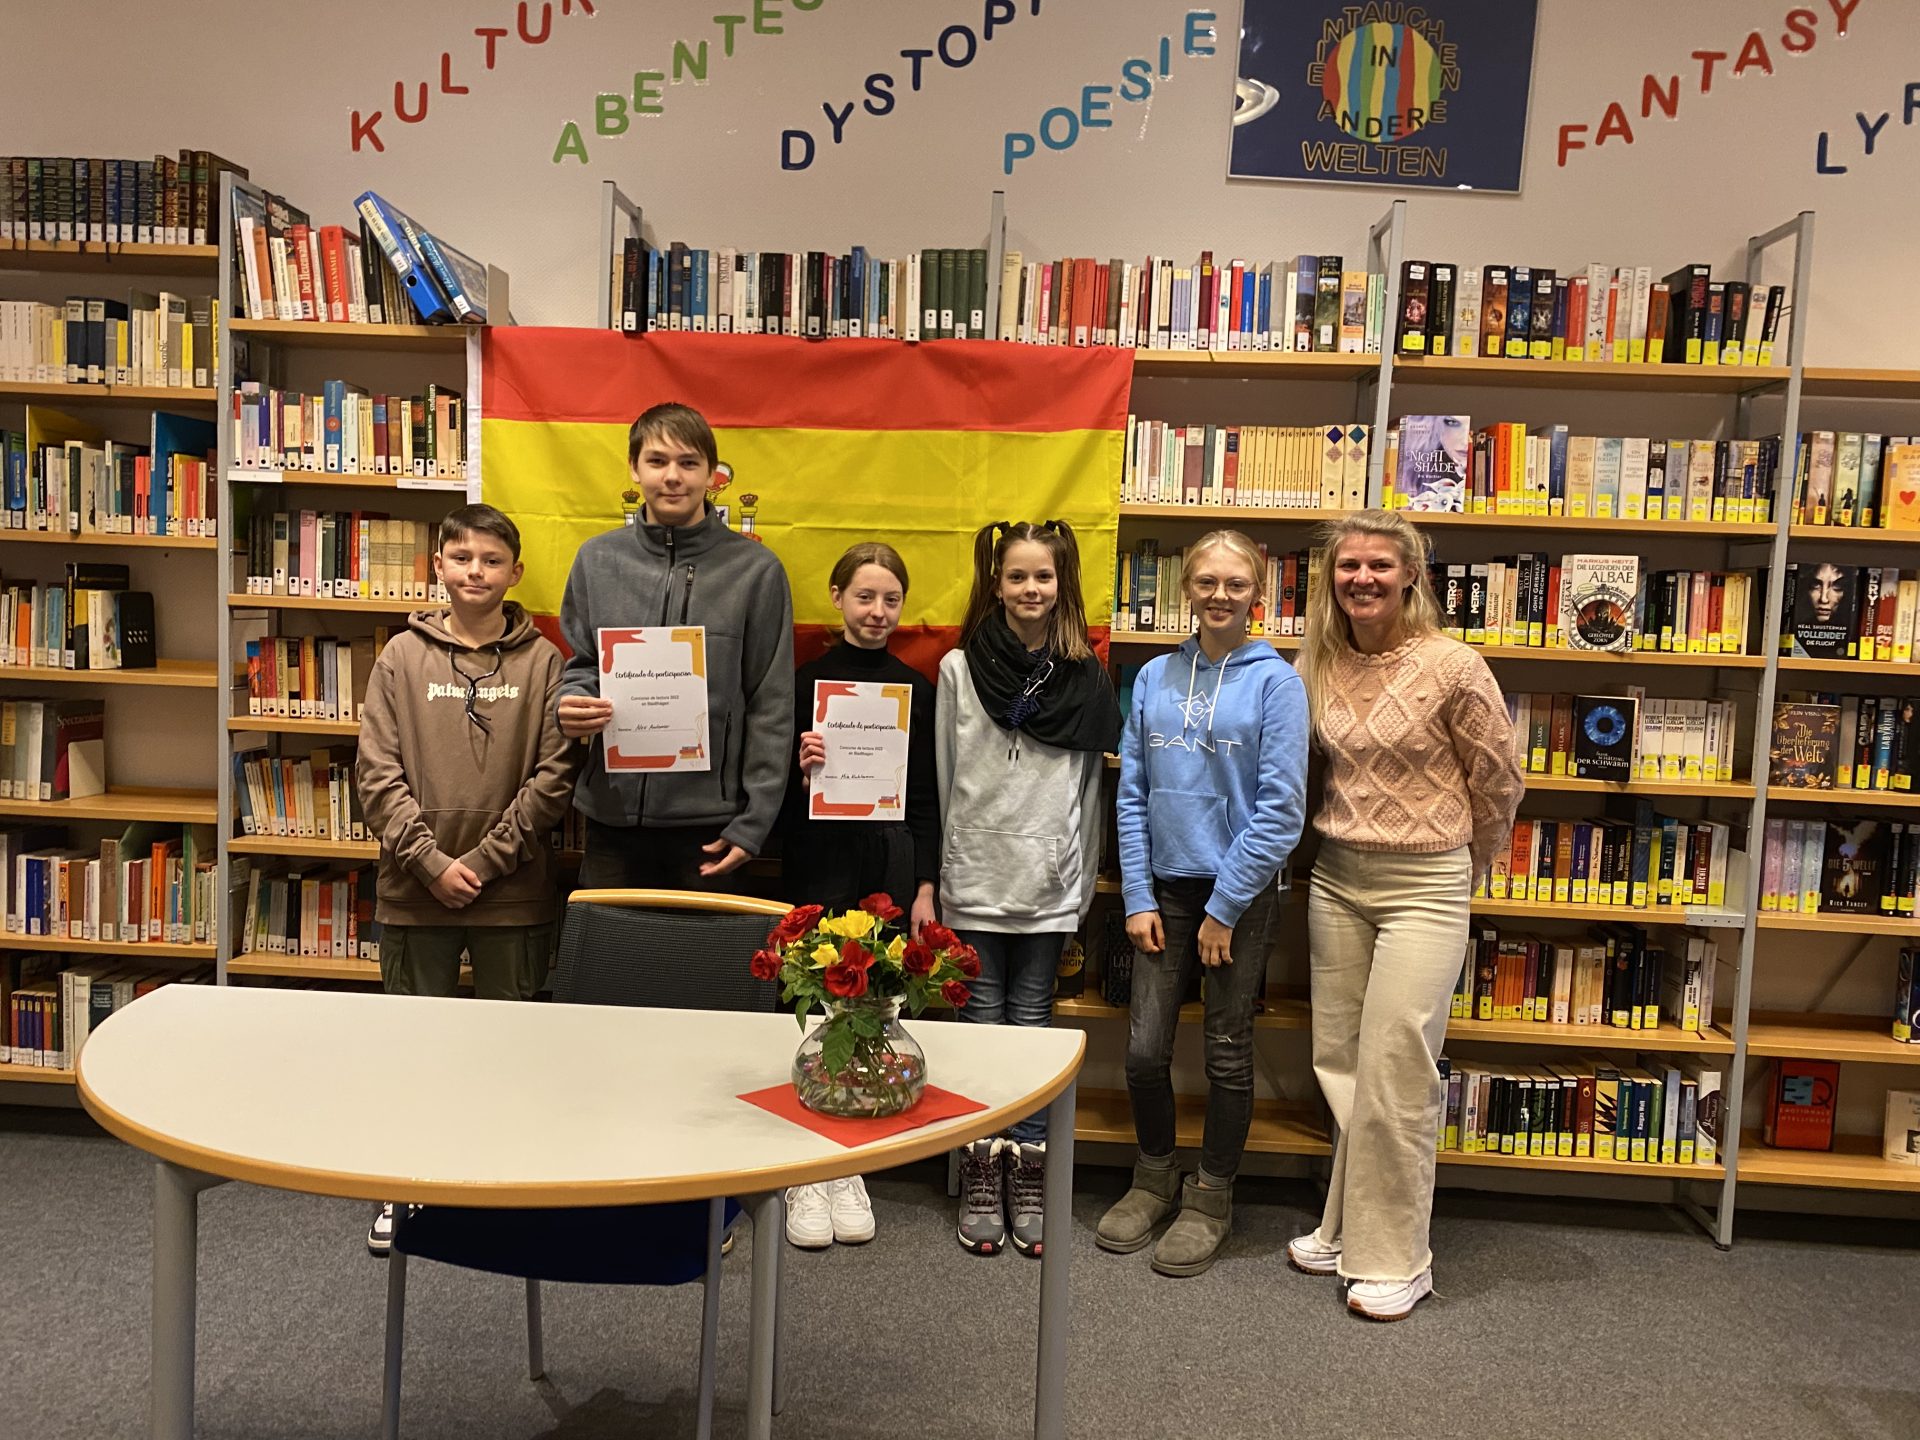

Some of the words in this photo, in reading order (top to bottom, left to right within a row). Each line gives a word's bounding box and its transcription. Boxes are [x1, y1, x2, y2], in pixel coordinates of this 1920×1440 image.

[1370, 44, 1397, 68] IN
[552, 0, 824, 164] ABENTE
[1557, 0, 1861, 168] FANTASY
[1003, 12, 1217, 175] POESIE
[1317, 100, 1447, 138] ANDERE
[1302, 141, 1447, 177] WELTEN
[1408, 450, 1444, 462] NIGHT
[1414, 462, 1456, 473] SHADE
[1589, 571, 1634, 584] ALBAE
[1446, 579, 1458, 615] METRO
[1470, 582, 1480, 614] METRO
[1797, 630, 1847, 640] VOLLENDET
[615, 669, 646, 680] Certificado
[475, 684, 519, 702] ngels
[827, 721, 855, 730] Certificado
[1794, 722, 1813, 738] Die
[1149, 733, 1242, 756] GANT
[1780, 746, 1793, 755] der
[1793, 745, 1824, 763] Welt
